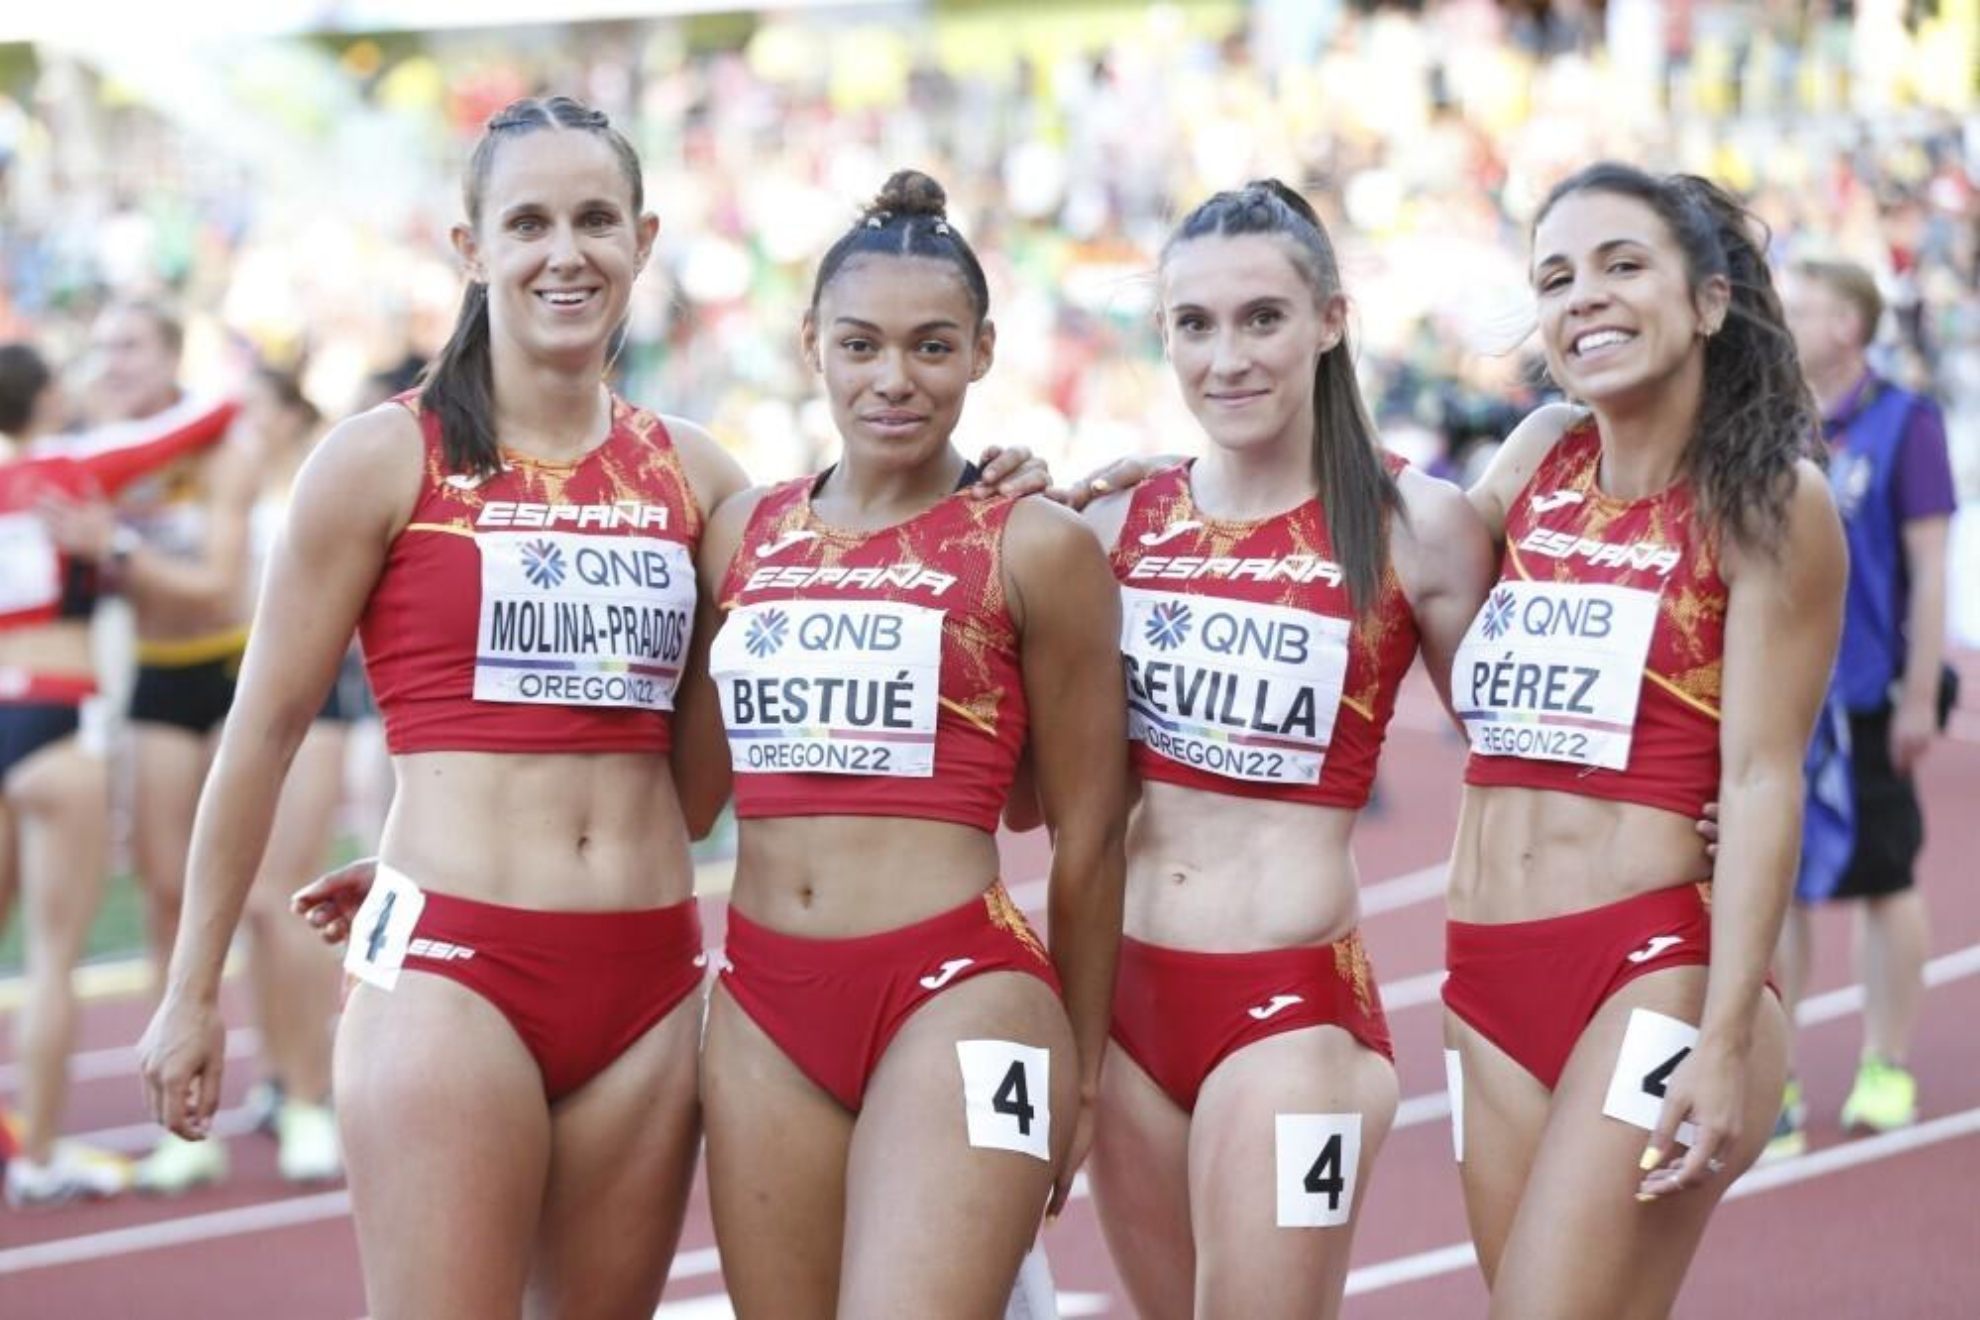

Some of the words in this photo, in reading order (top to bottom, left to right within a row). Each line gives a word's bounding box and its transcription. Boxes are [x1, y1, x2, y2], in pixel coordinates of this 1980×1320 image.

[476, 501, 667, 529] ESPAÑA
[576, 549, 669, 588] QNB
[1129, 555, 1341, 586] ESPAÑA
[1511, 528, 1681, 574] ESPAÑA
[744, 564, 957, 594] ESPAÑA
[491, 601, 686, 663] MOLINA-PRADOS
[800, 613, 902, 650] QNB
[1523, 596, 1612, 637] QNB
[1201, 612, 1309, 663] QNB
[519, 675, 653, 702] OREGON22
[733, 671, 913, 728] BESTUÉ
[1472, 651, 1600, 713] PÉREZ
[748, 743, 890, 771] OREGON22
[992, 1060, 1033, 1135] 4
[1304, 1134, 1343, 1209] 4
